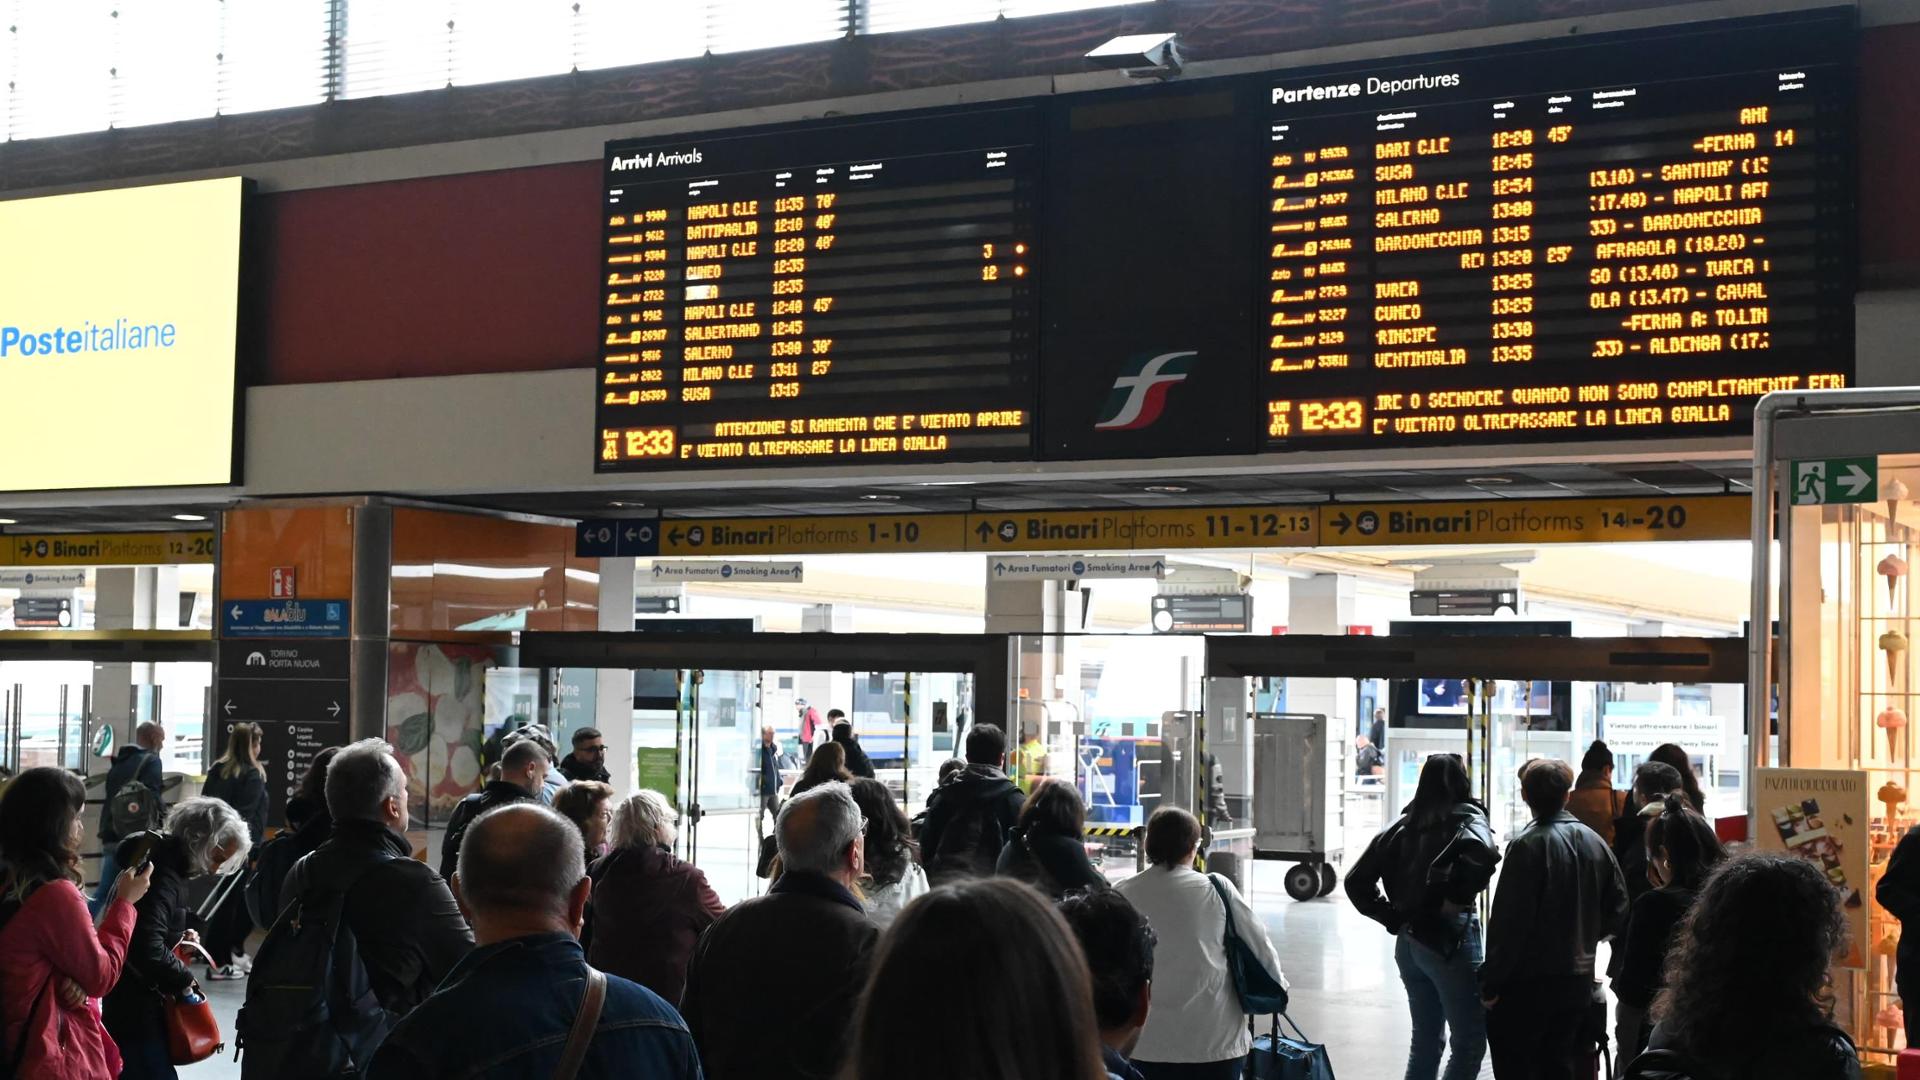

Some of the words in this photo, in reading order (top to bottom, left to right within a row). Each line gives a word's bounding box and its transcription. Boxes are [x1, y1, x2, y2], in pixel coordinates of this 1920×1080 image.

[1272, 84, 1360, 104] Partenze
[1367, 74, 1459, 95] Departures
[1493, 130, 1532, 148] 12:20
[611, 153, 652, 171] Arrivi
[656, 148, 702, 166] Arrivals
[1376, 164, 1412, 181] SUSA
[1492, 153, 1532, 171] 12:45
[1775, 129, 1793, 146] 14
[1376, 186, 1427, 205] MILANO
[1493, 177, 1532, 195] 12:54
[1493, 201, 1532, 218] 13:00
[1674, 185, 1732, 204] NAPOLI
[688, 203, 728, 220] NAPOLI
[775, 197, 804, 212] 11:35
[687, 221, 758, 240] BATTIPAGLIA
[775, 217, 803, 232] 12:10
[1493, 225, 1530, 243] 13:15
[687, 244, 727, 260] NAPOLI
[775, 238, 805, 253] 12:20
[1492, 249, 1532, 266] 13:20
[1597, 239, 1676, 259] AFRAGOLA
[686, 265, 721, 280] CUNEO
[774, 258, 804, 274] 12:35
[984, 244, 992, 258] 3
[773, 279, 803, 294] 12:35
[983, 265, 997, 280] 12
[1492, 273, 1532, 290] 13:25
[685, 305, 725, 320] NAPOLI
[772, 300, 803, 315] 12:40
[1492, 297, 1532, 314] 13:25
[1590, 291, 1620, 308] OLA
[1630, 287, 1688, 305] (13.47)
[685, 323, 760, 341] SALBERTRAND
[772, 320, 803, 335] 12:45
[1493, 321, 1532, 338] 13:30
[1691, 311, 1707, 327] A:
[1, 319, 175, 357] Posteitaliane
[684, 345, 732, 361] SALERNO
[772, 341, 802, 356] 13:00
[1492, 345, 1532, 362] 13:35
[683, 366, 723, 381] MILANO
[771, 362, 798, 377] 13:11
[682, 387, 711, 401] SUSA
[770, 383, 799, 397] 13:15
[1299, 400, 1363, 430] 12:33
[1410, 393, 1421, 409] O
[1512, 387, 1570, 404] QUANDO
[1579, 385, 1609, 402] NON
[1617, 383, 1658, 400] SONO
[1586, 410, 1606, 426] LA
[1671, 405, 1729, 422] GIALLA
[715, 420, 785, 436] ATTENZIONE!
[790, 419, 804, 434] SI
[809, 417, 867, 433] RAMMENTA
[873, 416, 897, 430] CHE
[920, 413, 971, 428] VIETATO
[977, 411, 1022, 426] APRIRE
[625, 429, 674, 456] 12:33
[697, 443, 743, 457] VIETATO
[748, 439, 834, 455] OLTREPASSARE
[840, 439, 856, 453] LA
[861, 437, 897, 452] LINEA
[903, 435, 947, 451] GIALLA
[1026, 518, 1098, 540] Binari
[1102, 517, 1195, 539] Platforms
[1389, 510, 1471, 533] Binari
[1476, 509, 1584, 532] Platforms
[712, 525, 774, 545] Binari
[778, 525, 858, 545] Platforms
[54, 540, 99, 557] Binari
[102, 540, 161, 556] Platforms
[665, 566, 683, 575] Area
[685, 566, 720, 575] Fumatori
[734, 566, 768, 577] Smoking
[770, 566, 790, 576] Area
[1008, 565, 1030, 573] Area
[1032, 564, 1071, 573] Fumatori
[1087, 563, 1127, 574] Smoking
[1129, 564, 1150, 573] Area
[269, 660, 292, 668] PORTA
[294, 660, 320, 668] NUOVA
[270, 650, 298, 658] TORINO
